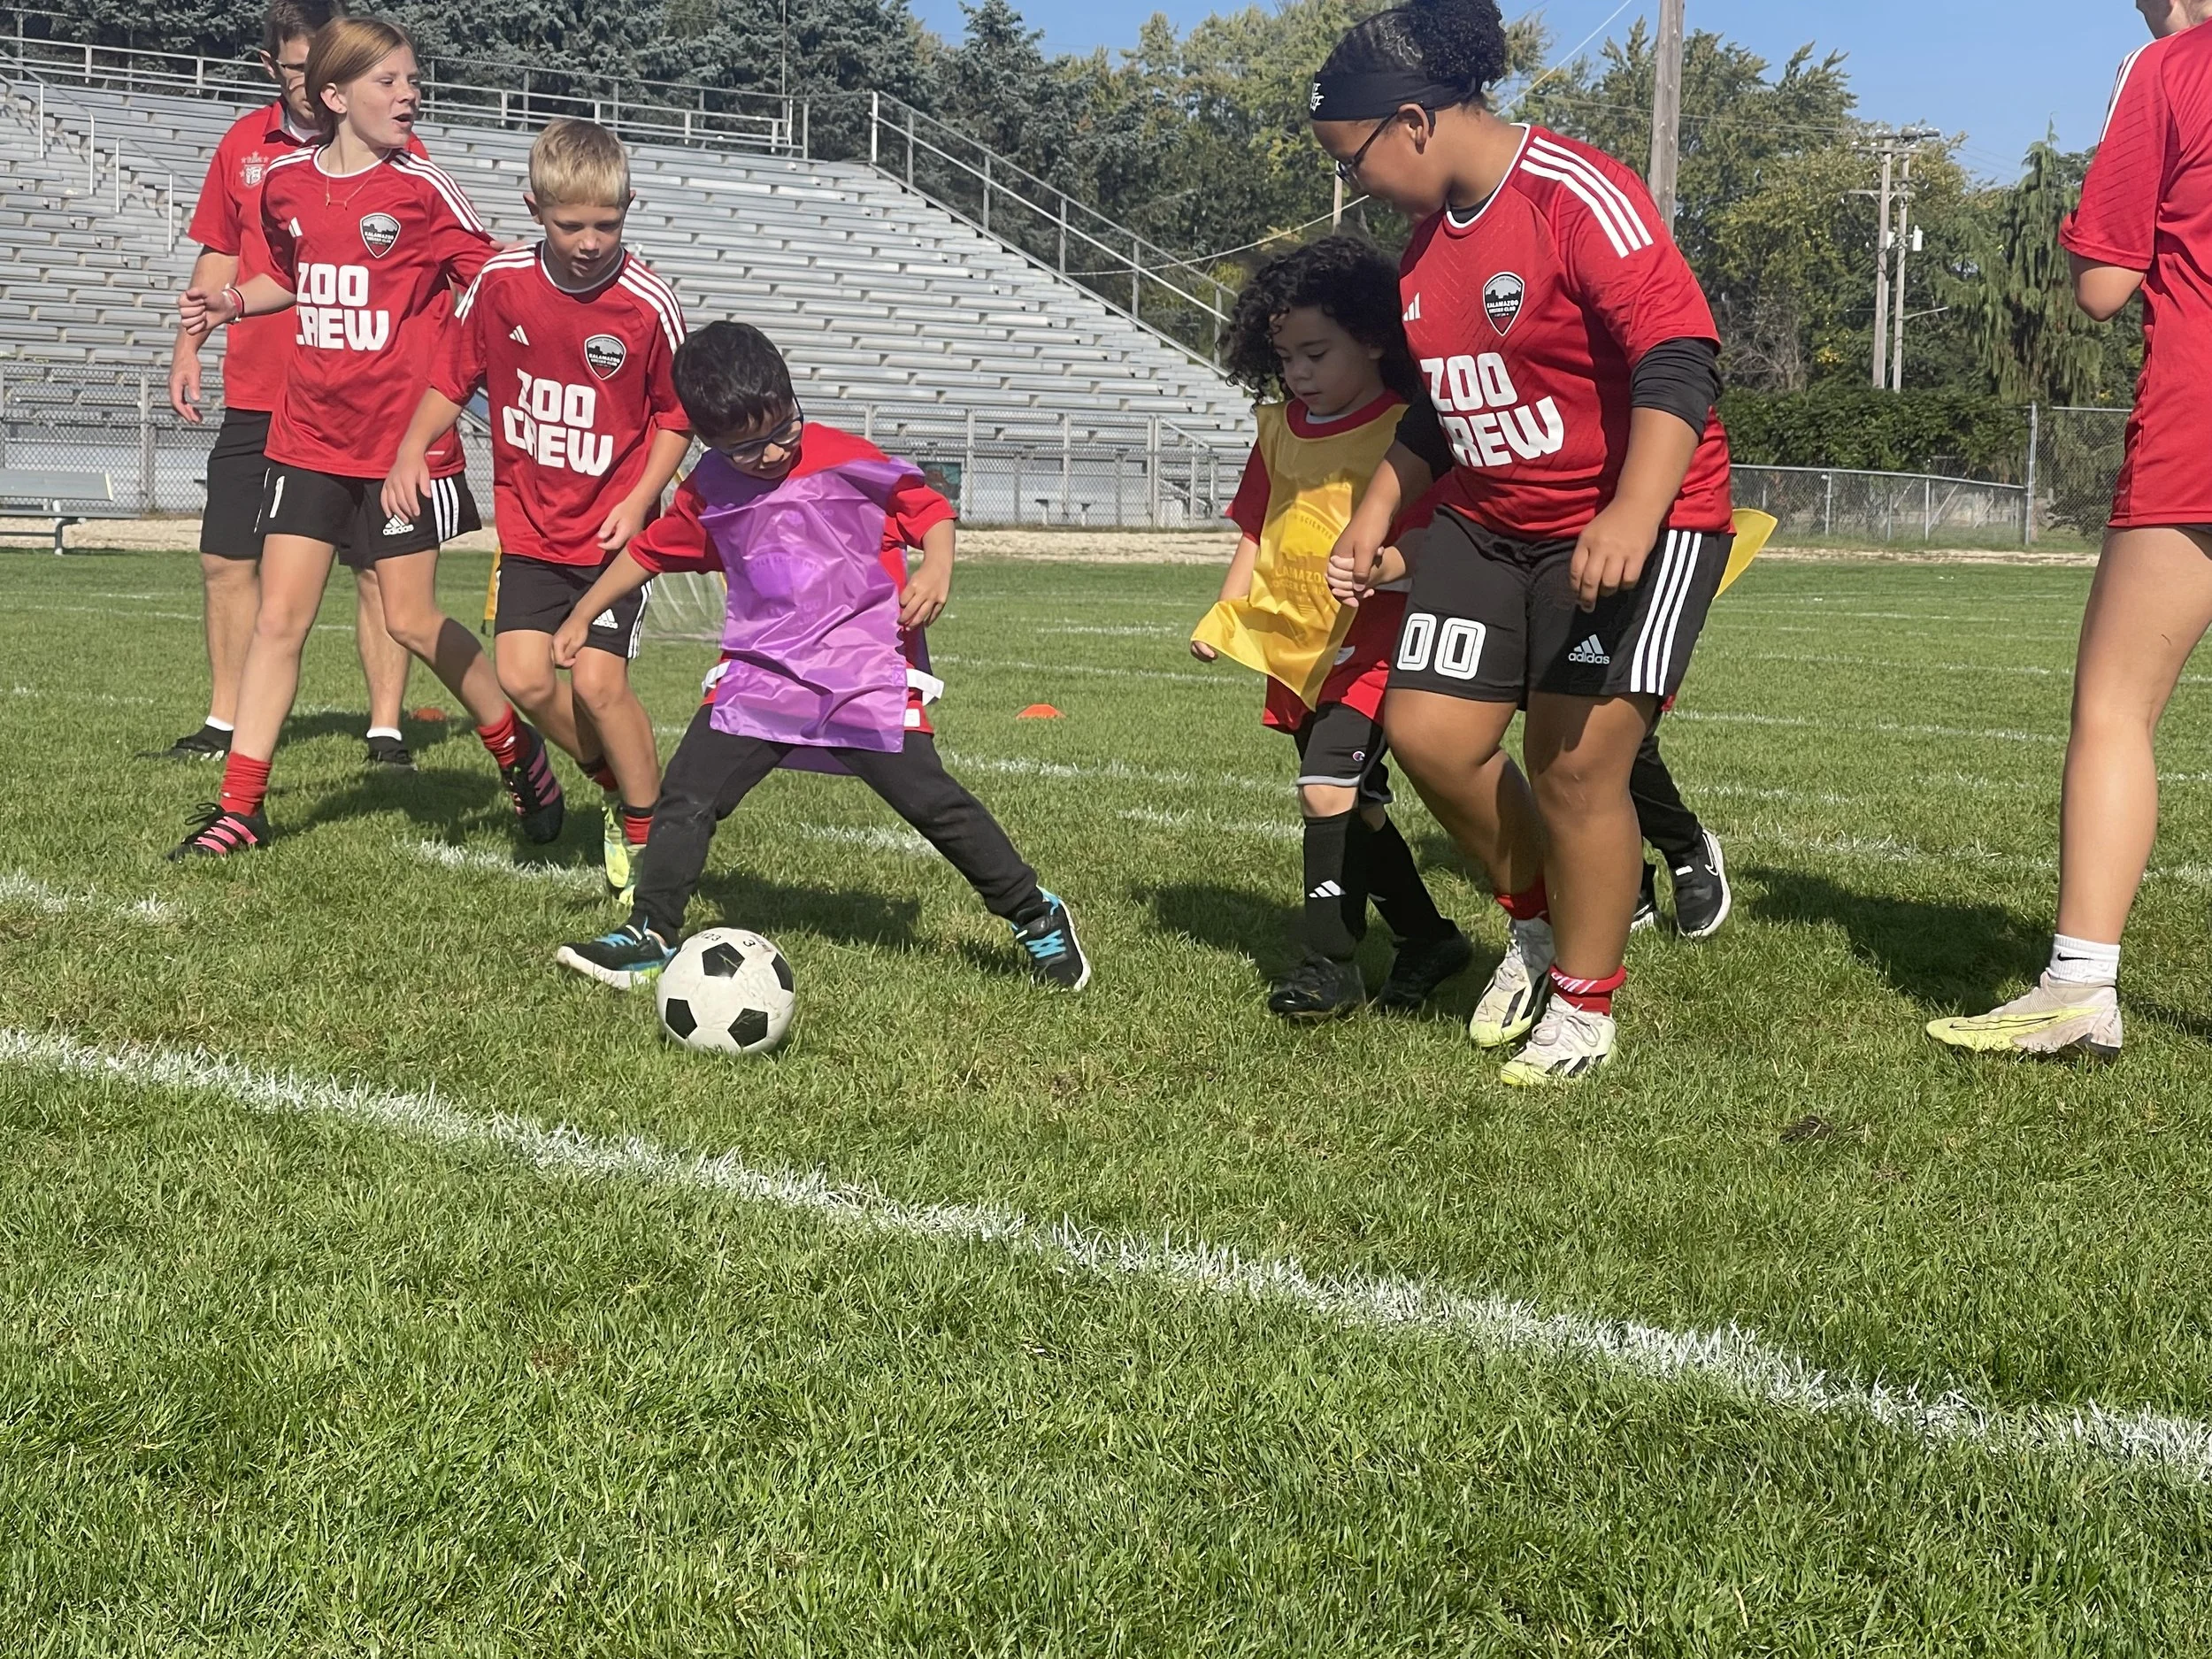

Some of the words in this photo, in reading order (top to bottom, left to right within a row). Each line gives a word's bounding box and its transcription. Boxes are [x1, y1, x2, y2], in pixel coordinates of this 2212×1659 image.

[296, 262, 369, 307] ZOO
[517, 367, 596, 429] ZOO
[1419, 352, 1518, 411] ZOO
[503, 405, 614, 477] CREW
[1437, 396, 1564, 468] REW
[1396, 612, 1487, 680] 00
[1568, 652, 1610, 664] adidas
